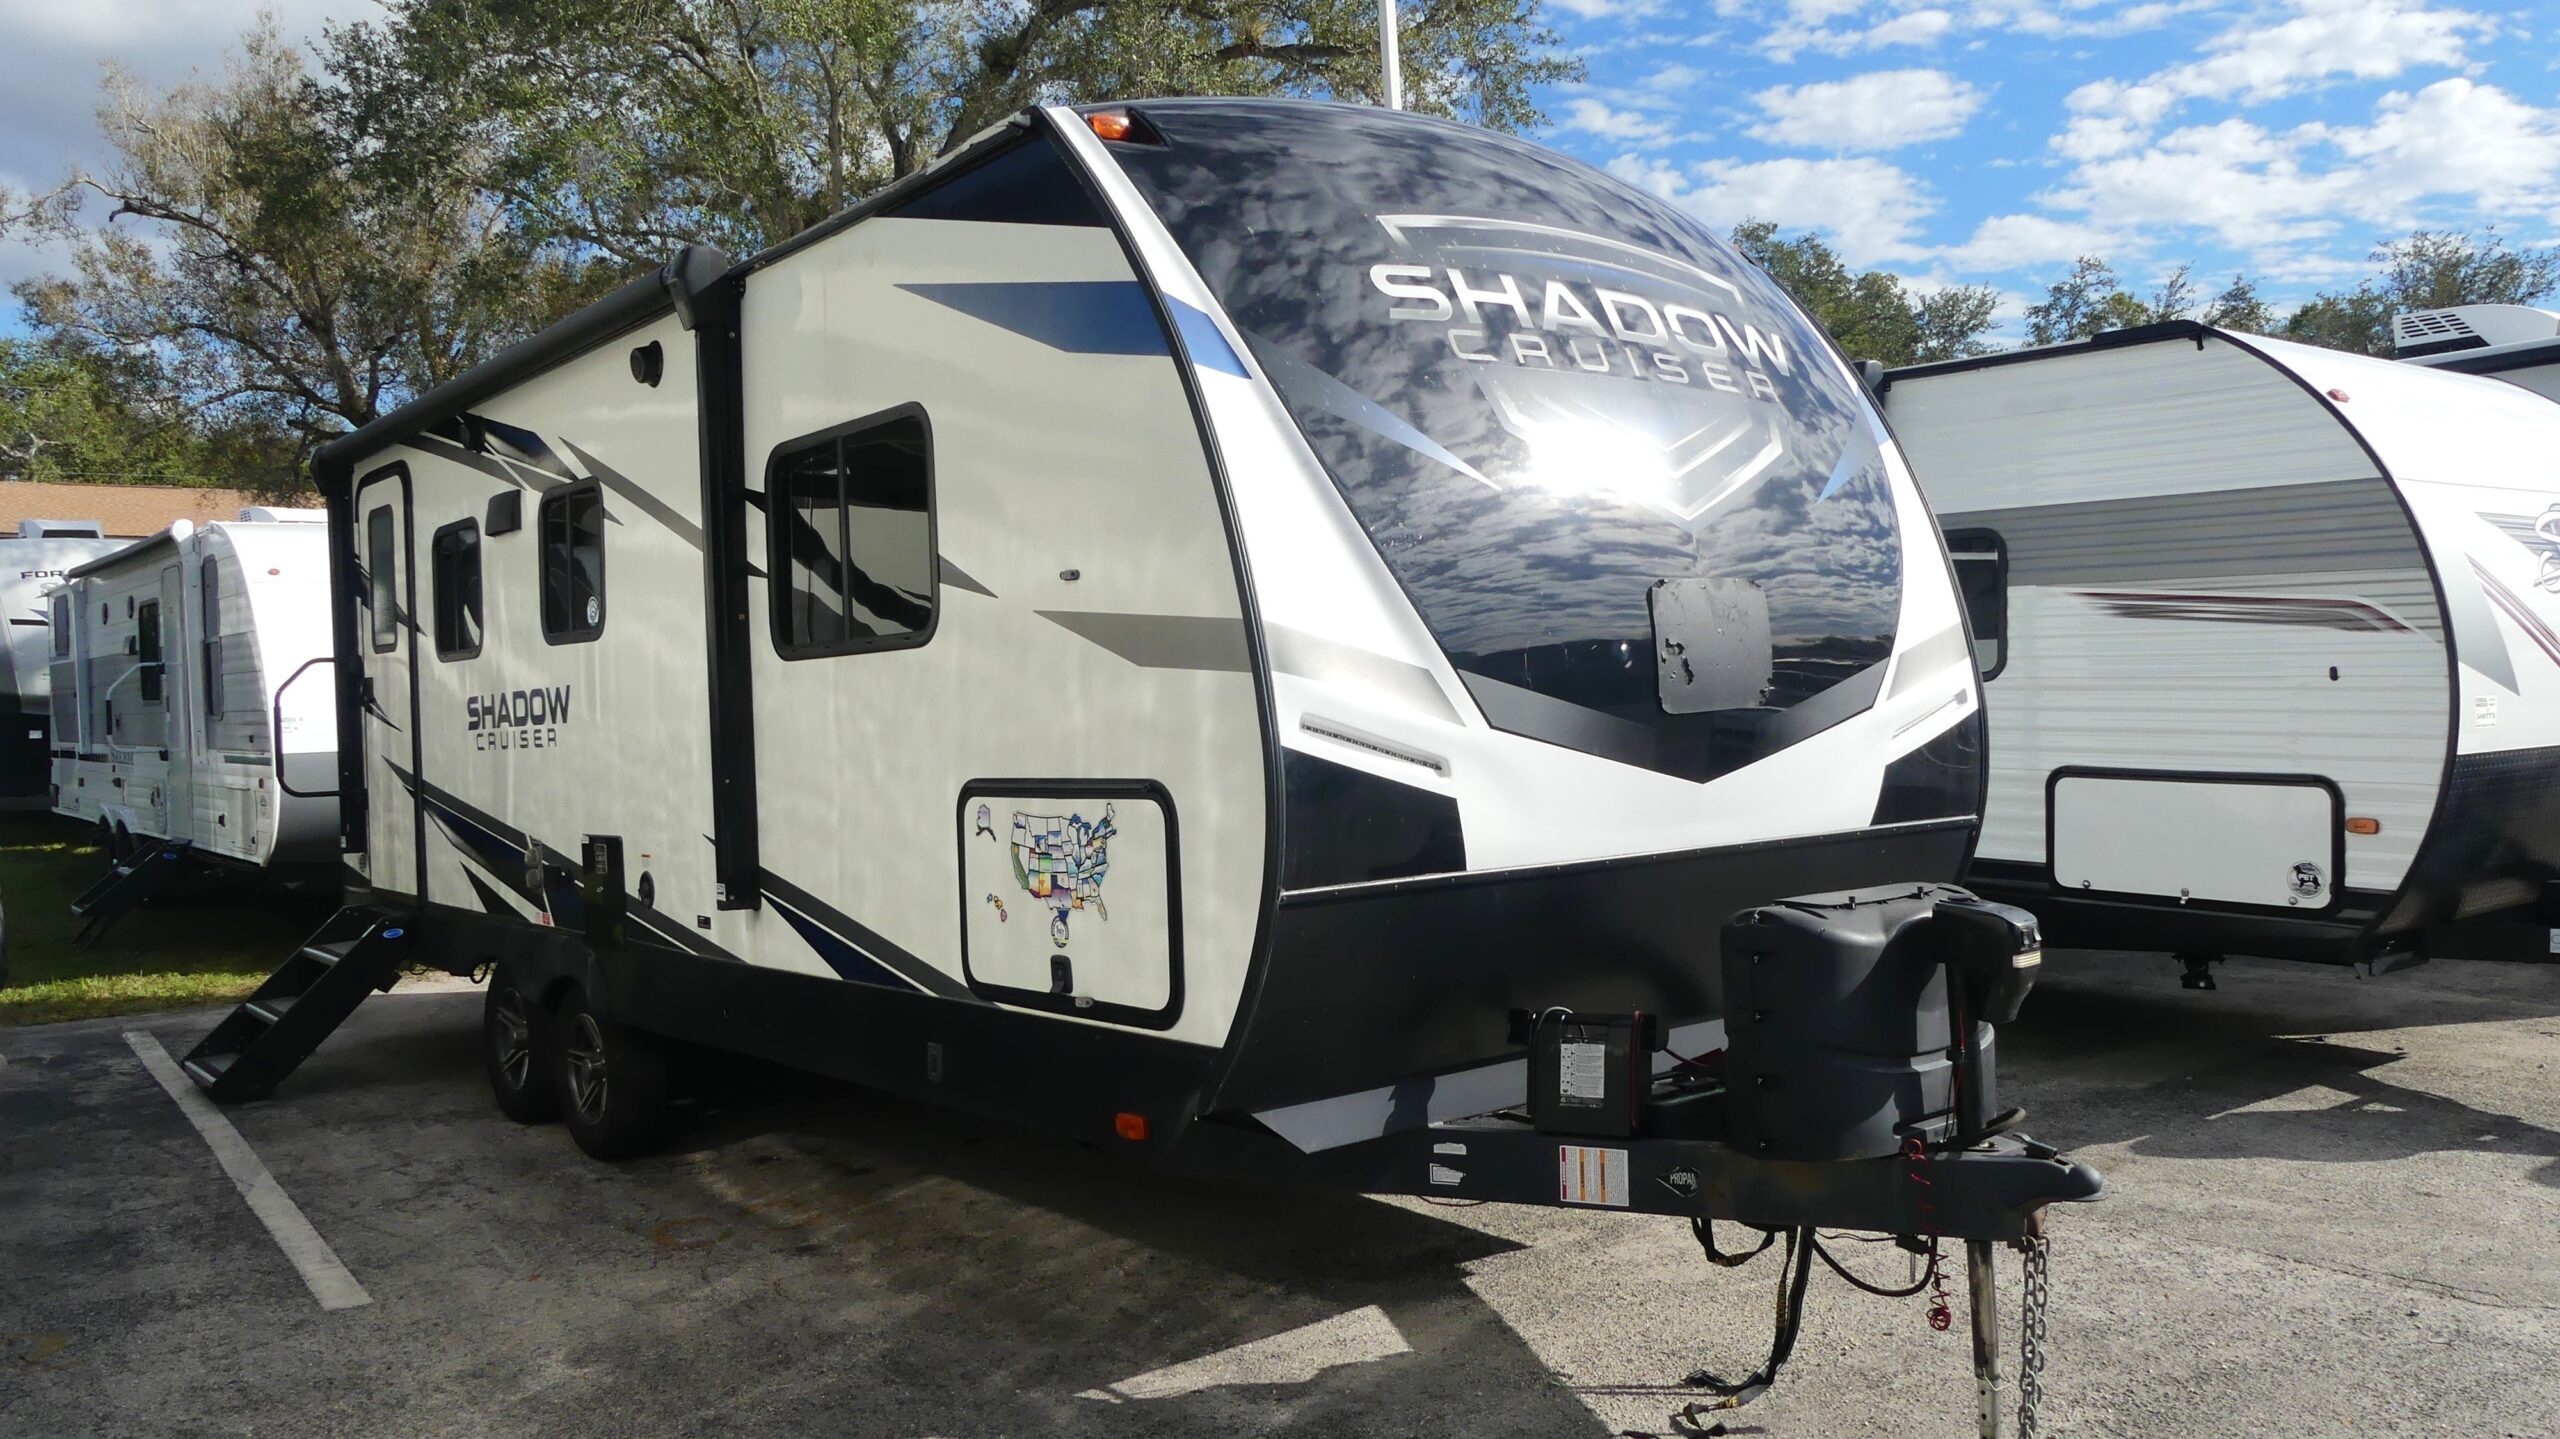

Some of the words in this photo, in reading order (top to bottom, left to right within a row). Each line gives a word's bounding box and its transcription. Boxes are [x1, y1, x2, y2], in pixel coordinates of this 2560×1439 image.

[1369, 263, 1791, 378] SHADOW
[1447, 328, 1780, 402] CRUISER
[467, 684, 571, 731] SHADOW
[476, 727, 558, 752] CRUISER
